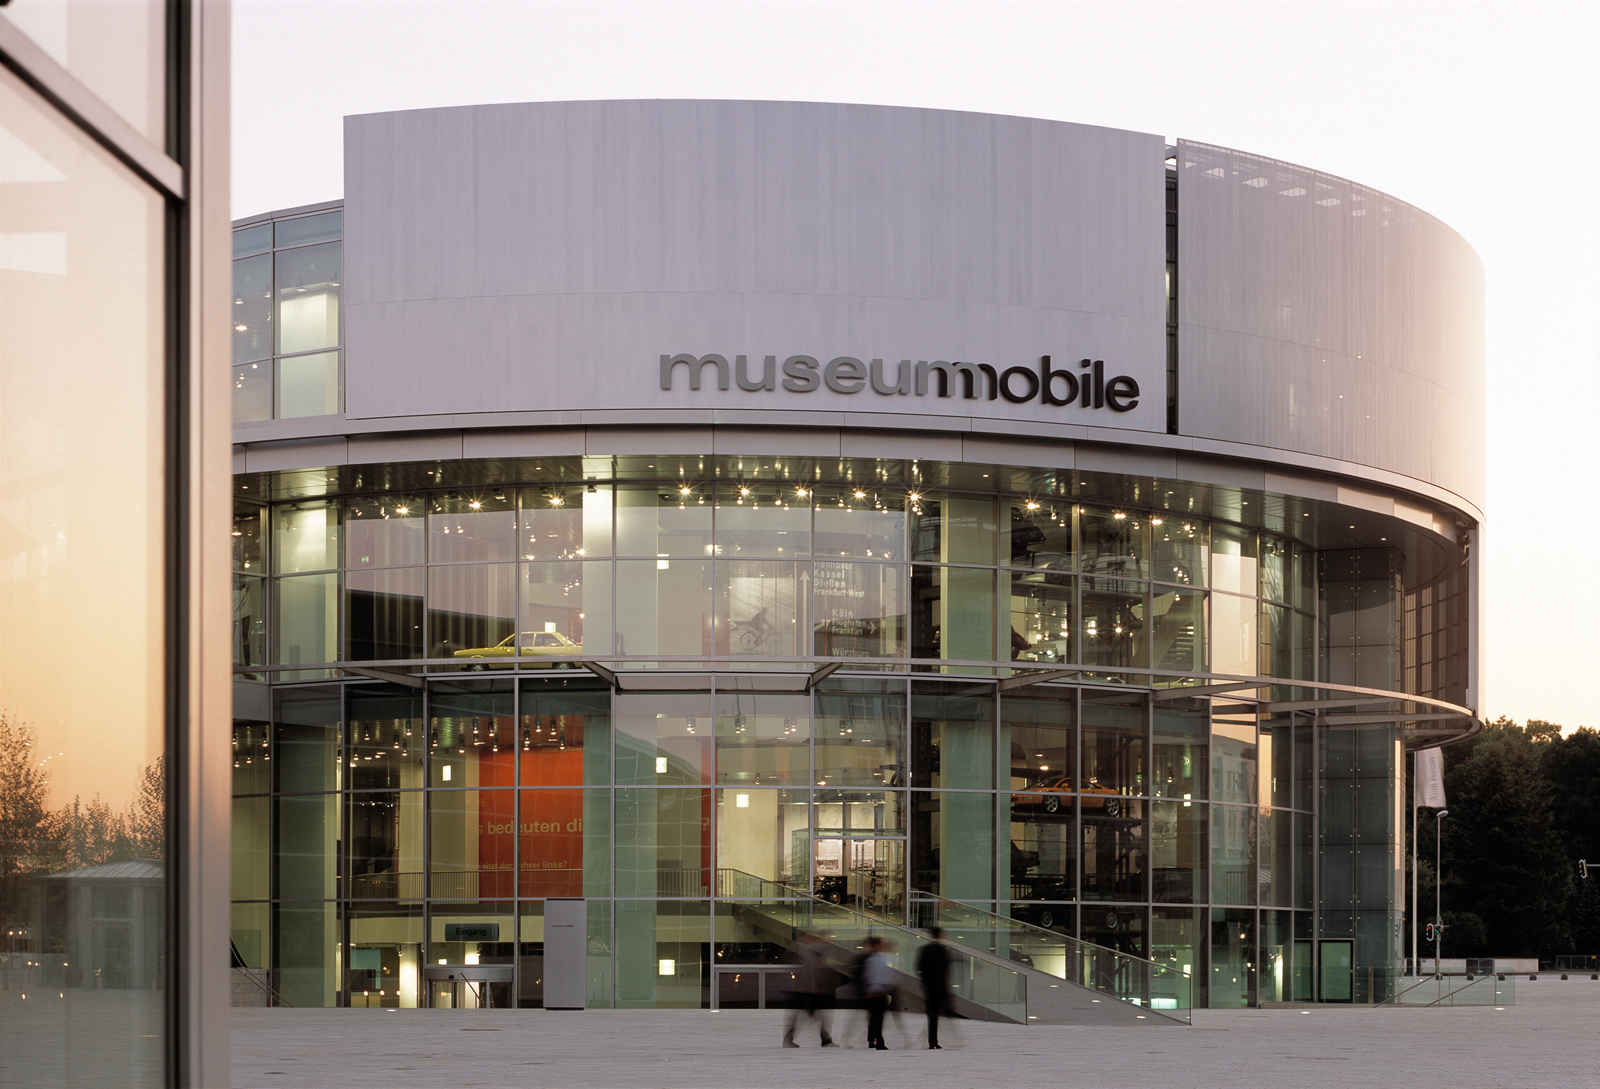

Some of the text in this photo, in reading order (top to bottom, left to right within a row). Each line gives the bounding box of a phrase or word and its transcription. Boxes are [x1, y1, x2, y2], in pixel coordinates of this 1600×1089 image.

[813, 569, 845, 579] Kassel
[832, 608, 854, 618] Köln
[487, 820, 560, 835] beduten
[455, 927, 487, 937] Eingang
